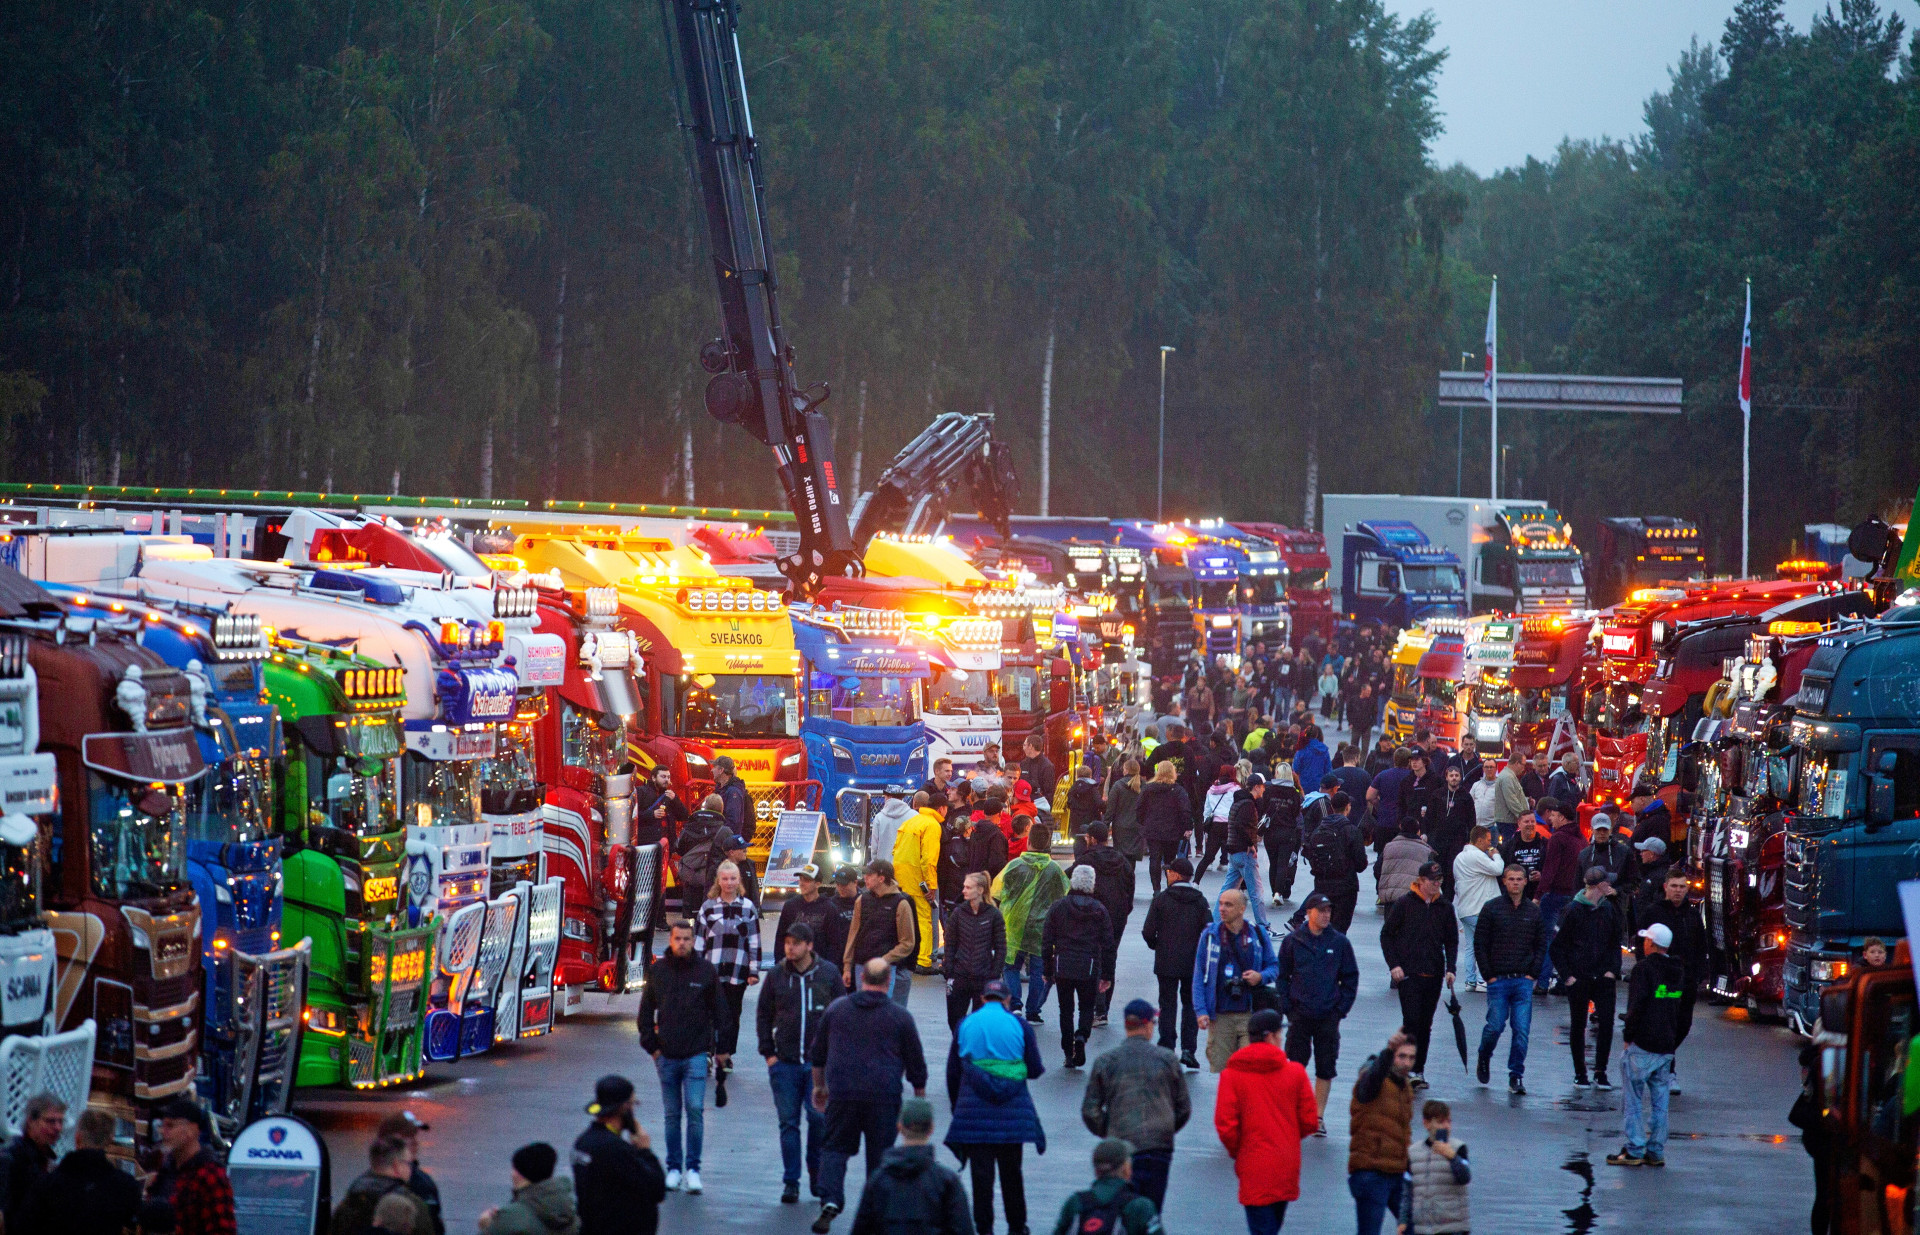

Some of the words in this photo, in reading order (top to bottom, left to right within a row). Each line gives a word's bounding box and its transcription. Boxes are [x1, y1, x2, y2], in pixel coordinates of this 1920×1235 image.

[823, 461, 837, 490] HIAB
[803, 475, 818, 511] X-HIPRO
[811, 512, 822, 534] 1058
[710, 632, 763, 645] SVEASKOG
[1478, 649, 1509, 660] DANMARK
[959, 735, 991, 747] VOLVO
[733, 759, 771, 771] CANIA
[860, 753, 902, 766] SCANIA
[511, 822, 527, 835] TEXEL
[247, 1147, 303, 1160] SCANIA
